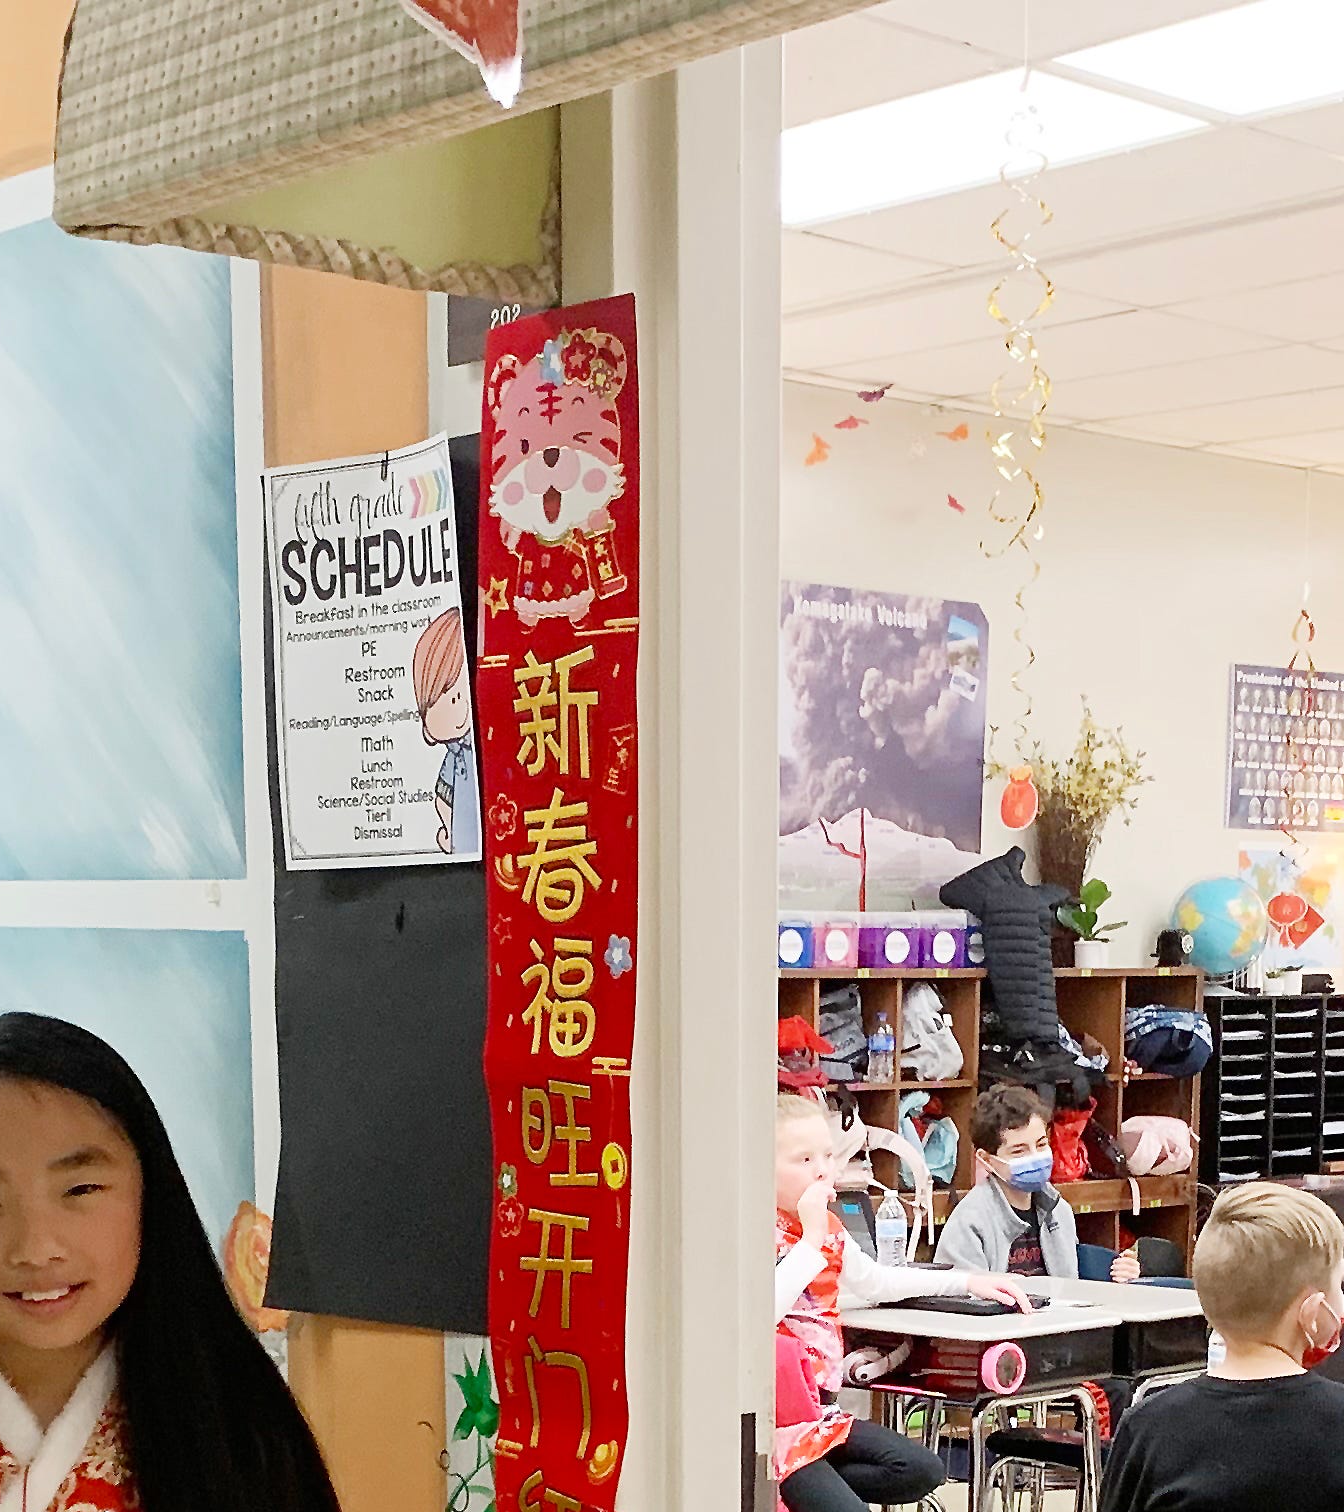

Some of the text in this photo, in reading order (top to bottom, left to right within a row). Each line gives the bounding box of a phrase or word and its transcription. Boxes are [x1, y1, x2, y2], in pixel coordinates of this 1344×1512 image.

[281, 517, 454, 606] SCHEDULE
[295, 595, 442, 625] Breakfast in the classroom
[877, 604, 928, 630] Volcano
[286, 616, 432, 642] Announcements/morning work
[361, 640, 377, 657] PE
[344, 665, 406, 684] Restroom
[1236, 670, 1282, 686] Presidents
[358, 684, 395, 703] Snack
[289, 708, 421, 731] Reading/Language/Spelling
[361, 734, 394, 753] Math
[361, 758, 393, 773] Lunch
[350, 776, 404, 791] Restroom
[317, 789, 434, 809] Science/Social Studies
[354, 824, 403, 840] Dismissal
